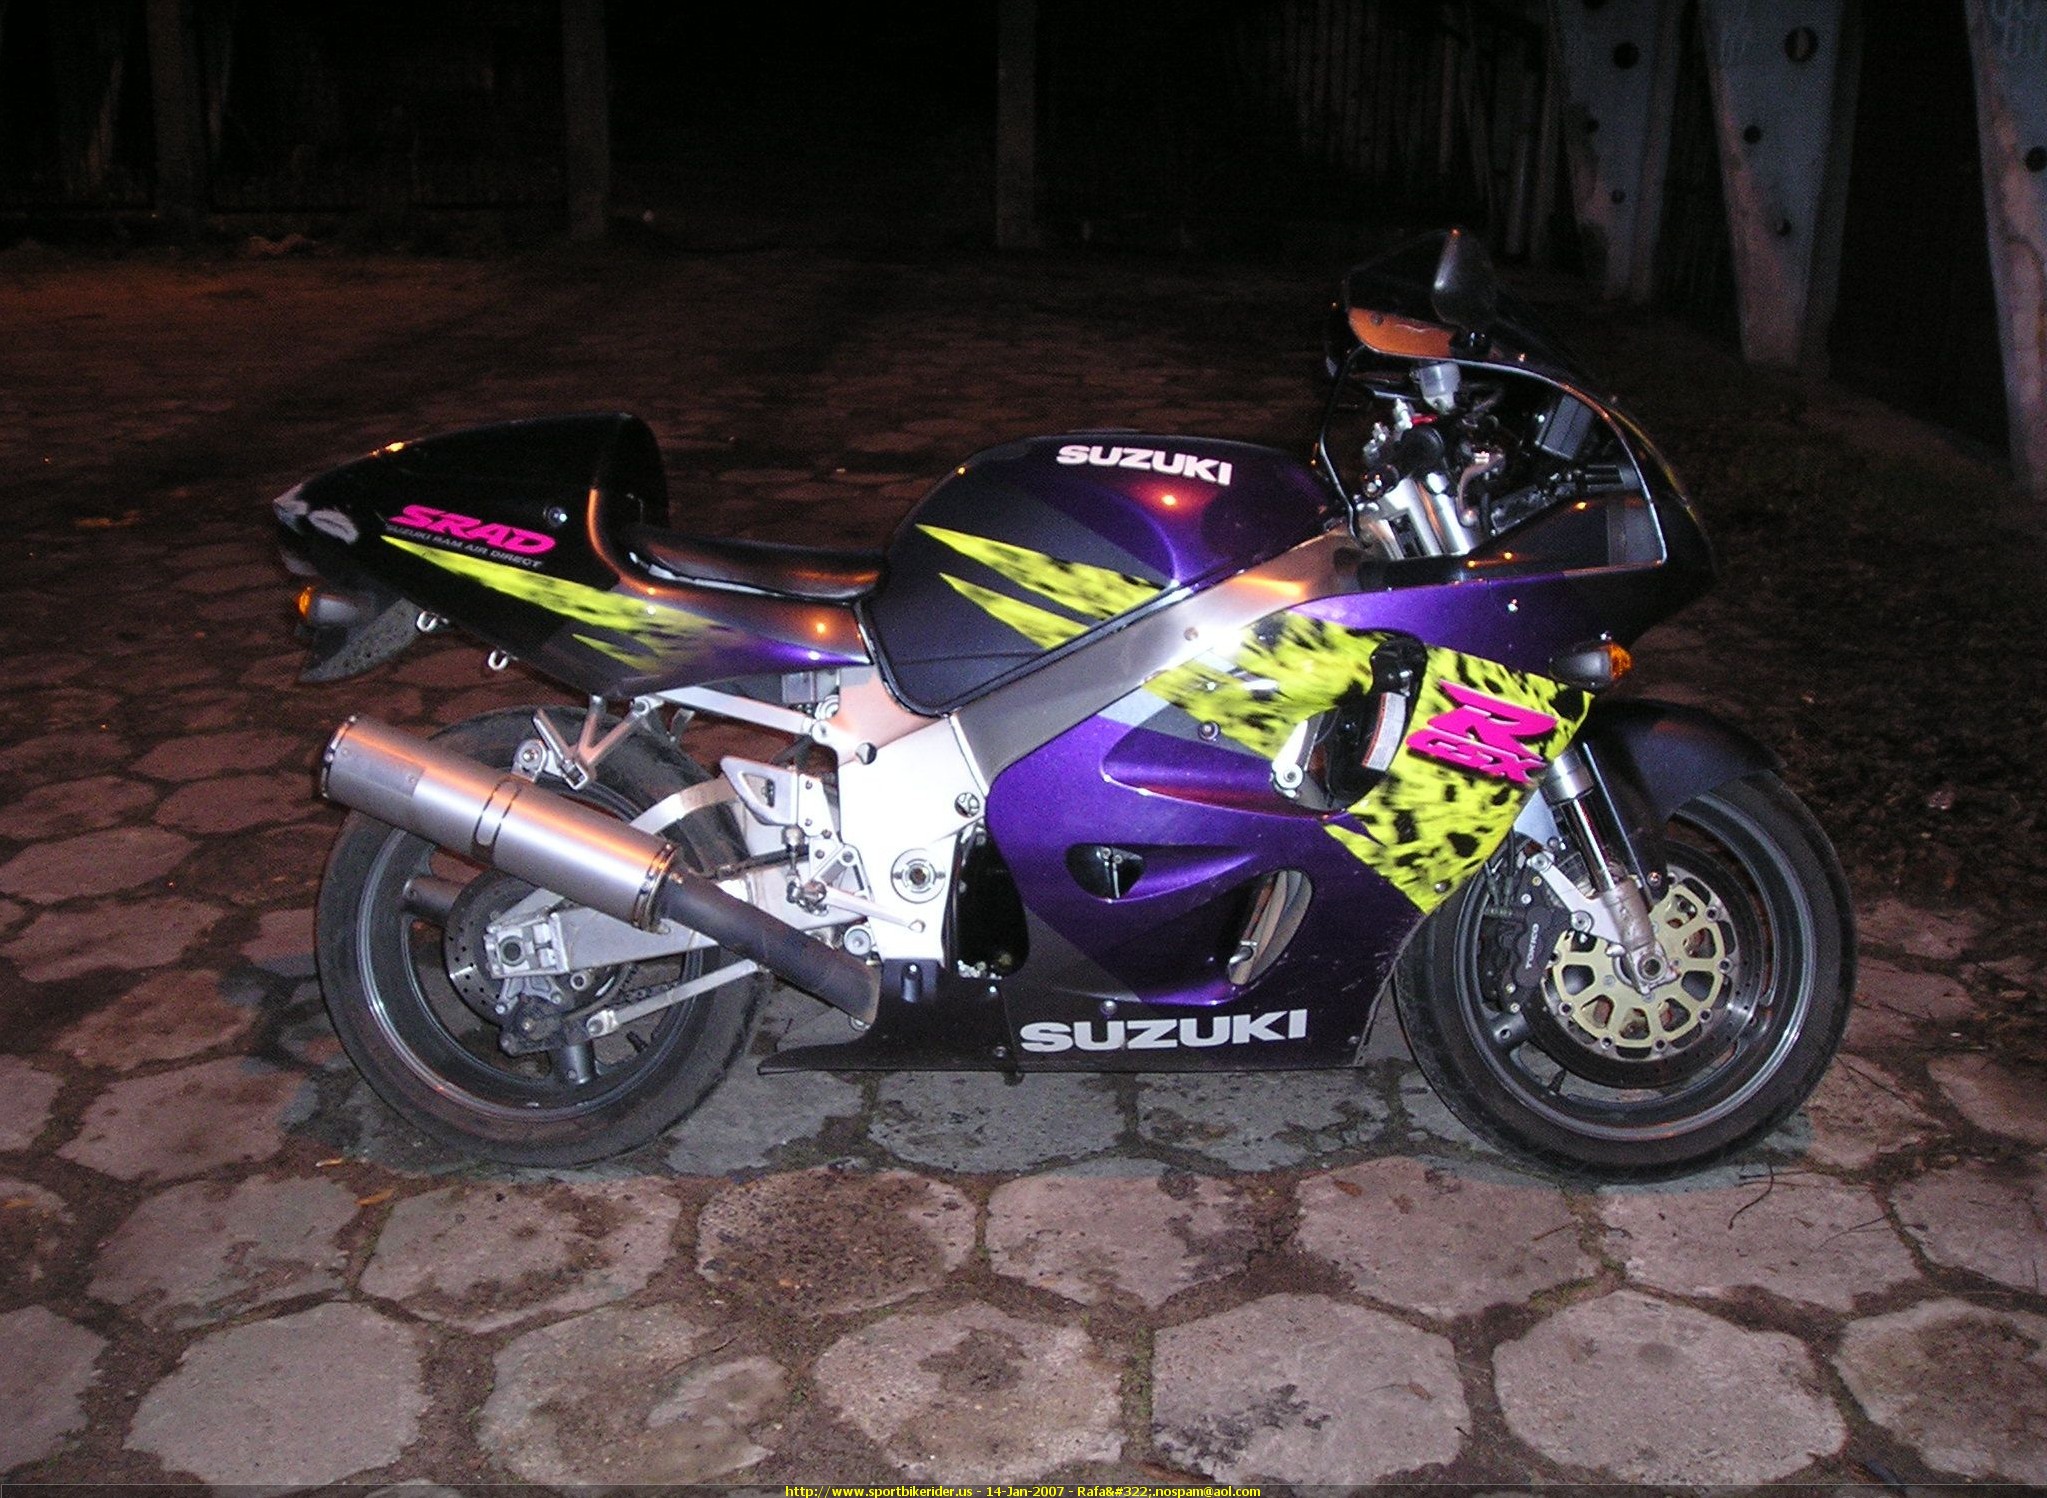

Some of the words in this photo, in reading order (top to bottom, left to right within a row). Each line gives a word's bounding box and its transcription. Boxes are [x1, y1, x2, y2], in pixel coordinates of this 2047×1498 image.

[1056, 445, 1233, 486] SUZUKI
[389, 504, 557, 556] SRAD
[1525, 923, 1540, 969] TOKICO
[1019, 1009, 1308, 1053] SUZUKI
